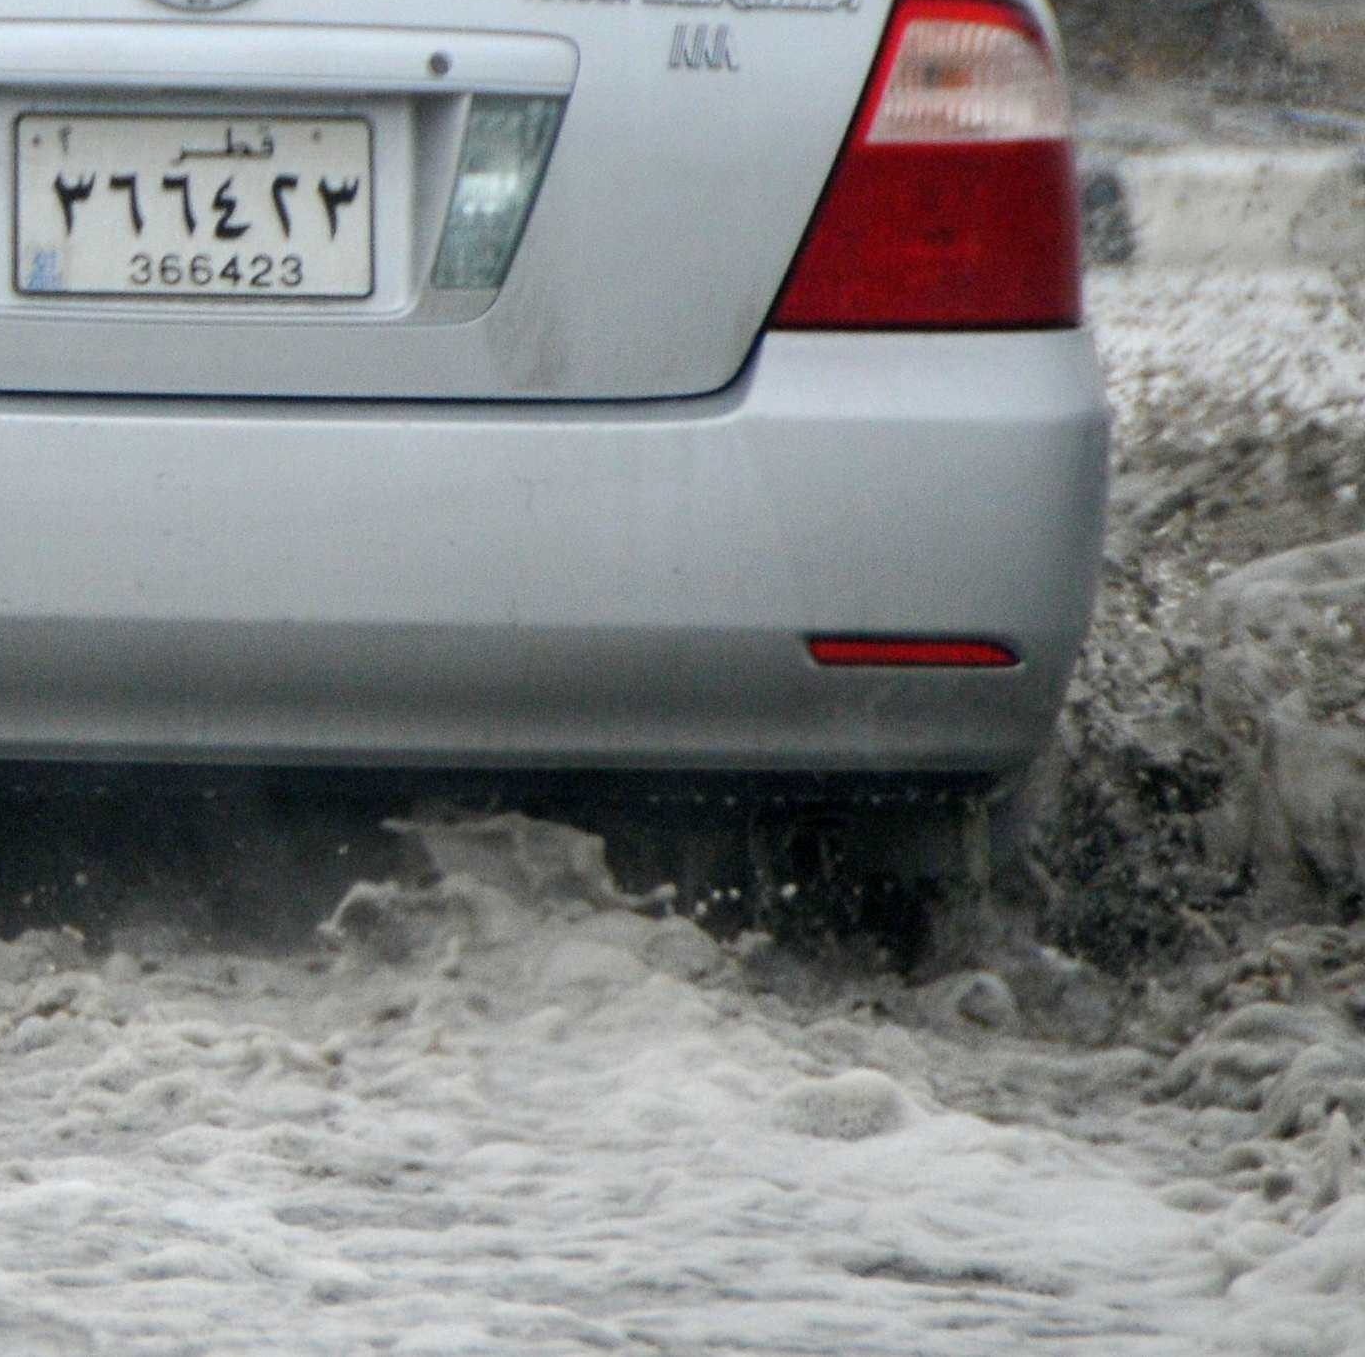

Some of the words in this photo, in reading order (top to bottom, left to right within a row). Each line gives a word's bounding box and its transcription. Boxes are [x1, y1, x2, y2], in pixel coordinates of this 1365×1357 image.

[171, 123, 275, 166] قطر
[53, 171, 361, 242] ٣٦٦٤٢٣
[129, 253, 304, 288] 366423
